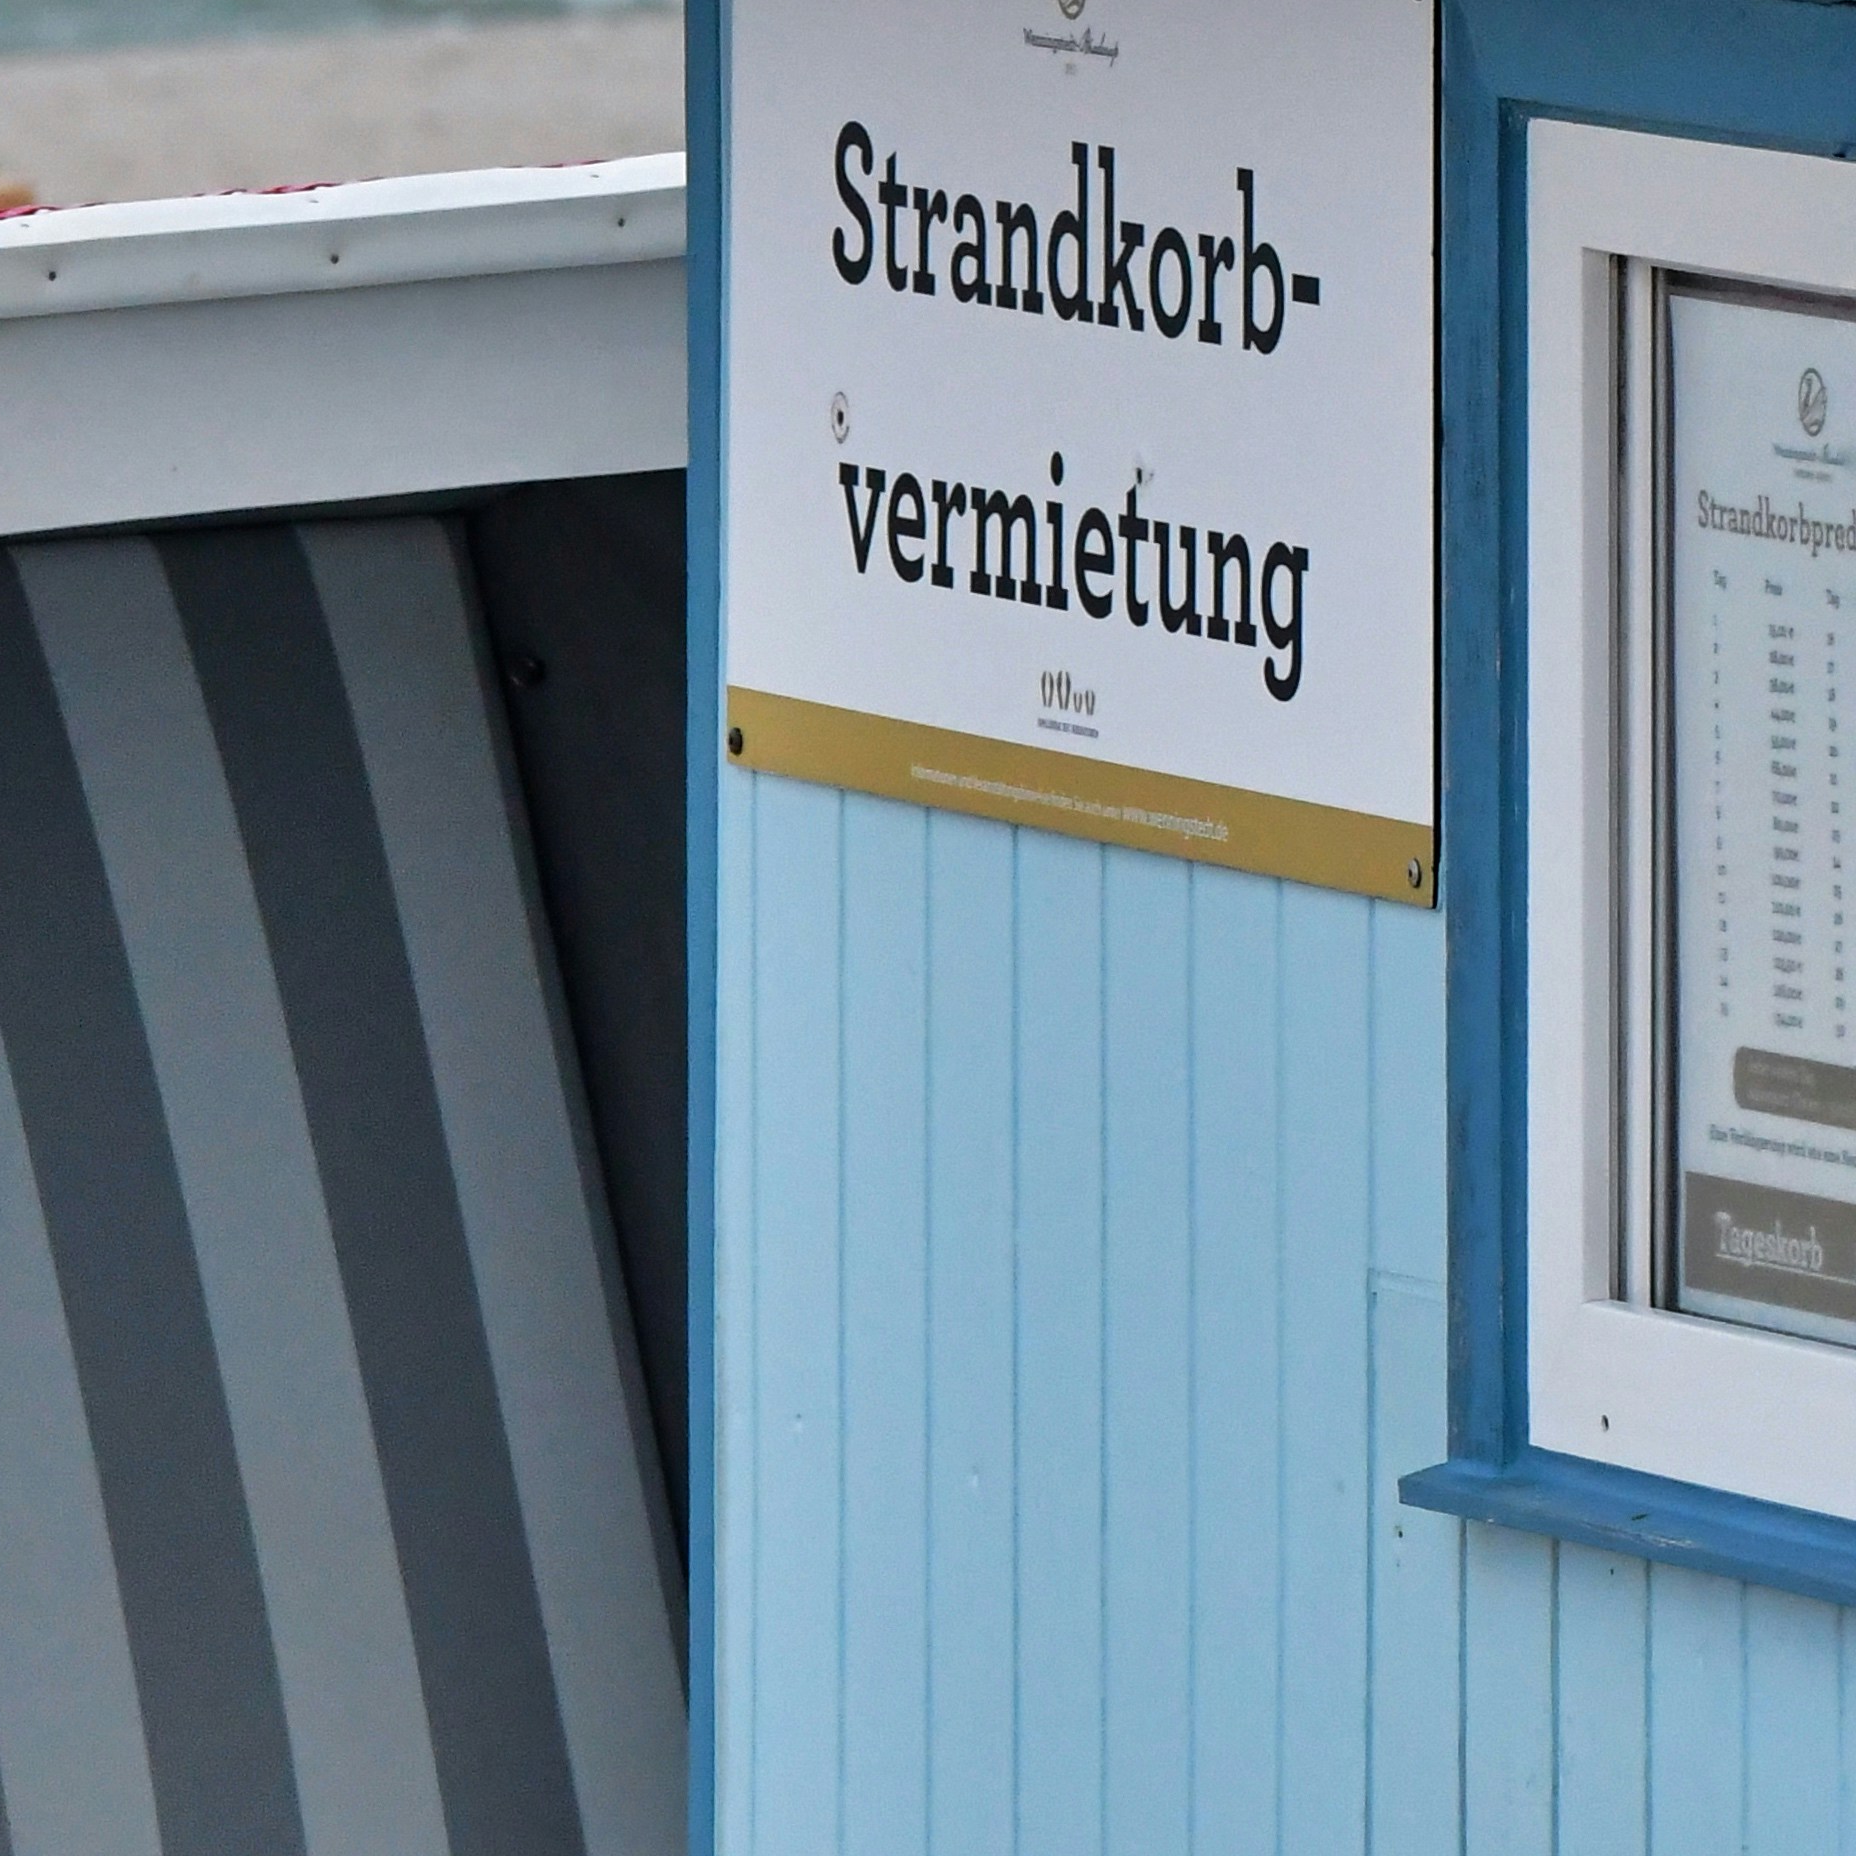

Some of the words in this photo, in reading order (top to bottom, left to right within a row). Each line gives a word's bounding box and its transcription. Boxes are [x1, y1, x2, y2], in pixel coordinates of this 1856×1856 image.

[833, 121, 1321, 354] Strandkorb-
[838, 452, 1309, 702] vermietung
[1714, 1211, 1824, 1272] Tageskorb
